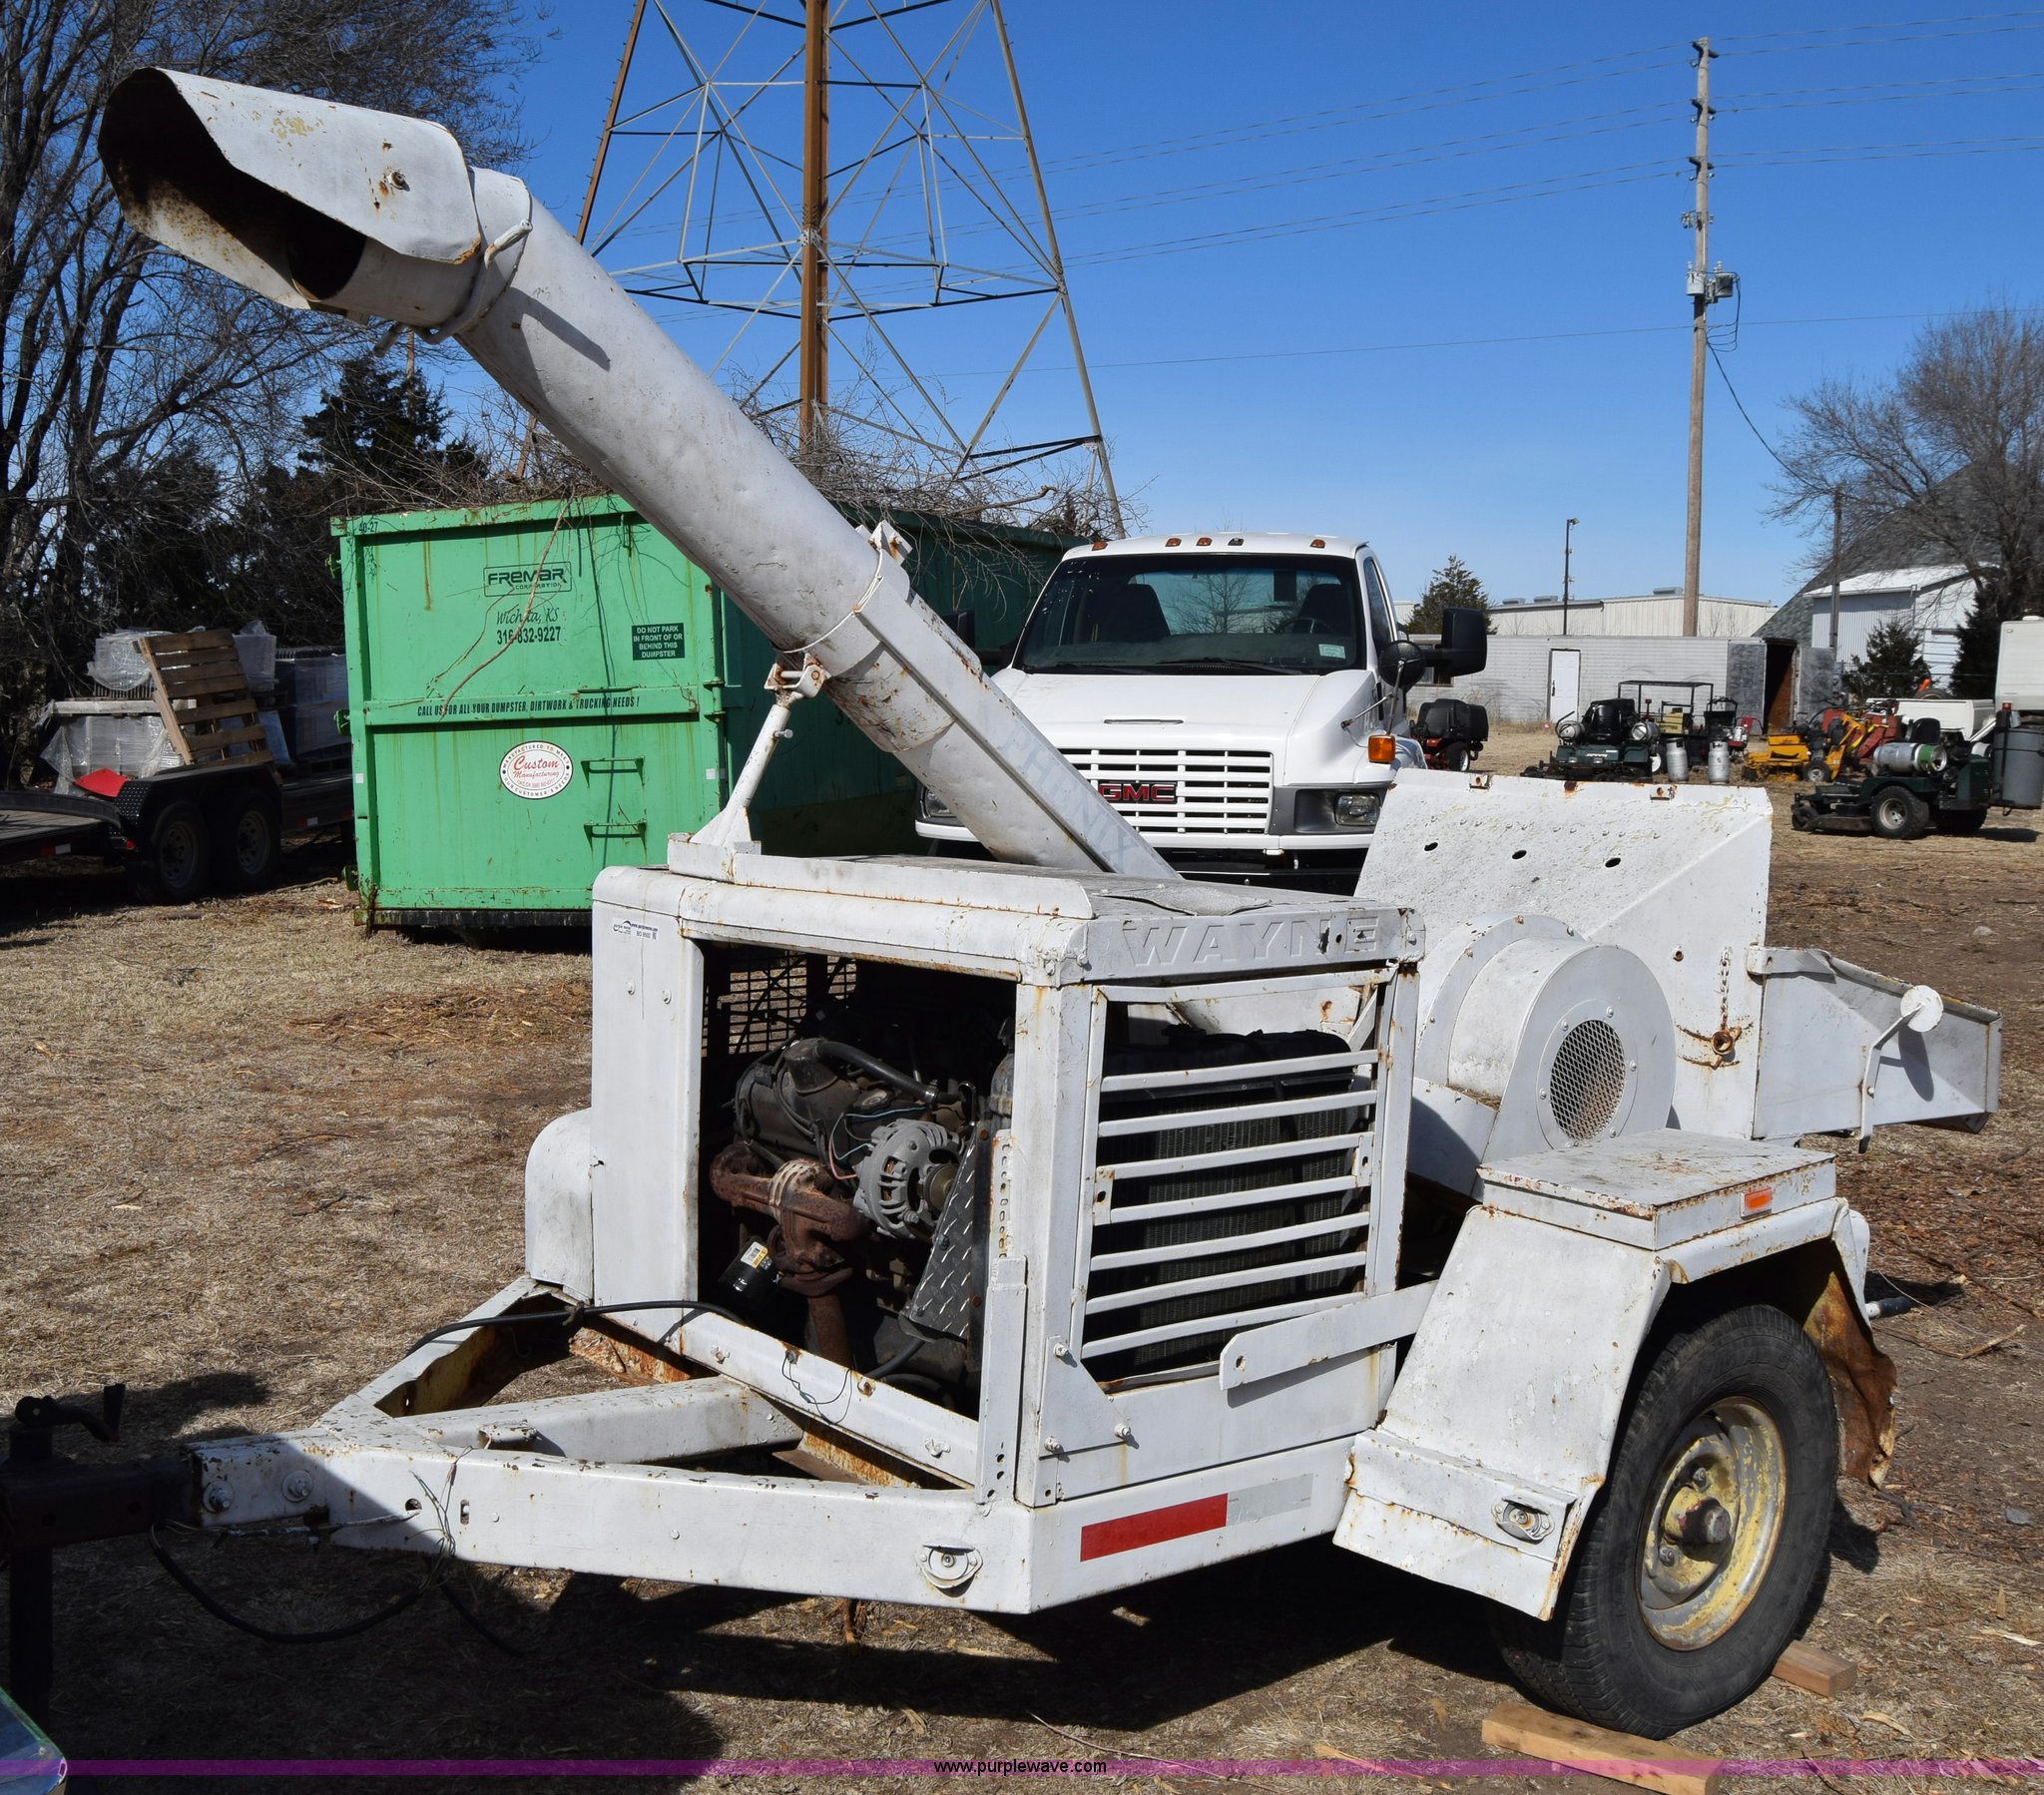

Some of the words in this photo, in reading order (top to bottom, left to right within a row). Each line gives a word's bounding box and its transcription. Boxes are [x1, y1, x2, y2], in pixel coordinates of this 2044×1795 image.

[487, 568, 567, 587] FREMAR
[546, 607, 560, 623] KS
[661, 625, 679, 634] PARK
[639, 642, 663, 651] BEHIND
[641, 650, 676, 659] DUMPSTER
[417, 705, 432, 716] CALL
[458, 703, 470, 714] ALL
[472, 702, 490, 713] YOUR
[530, 699, 567, 711] DIRTWORK
[568, 700, 574, 709] &
[576, 697, 611, 709] TRUCKING
[612, 696, 635, 707] NEEDS
[503, 744, 544, 768] MANUFACTURED
[513, 754, 560, 770] Custom
[1098, 782, 1177, 801] GMC
[1122, 915, 1379, 968] WAYNE
